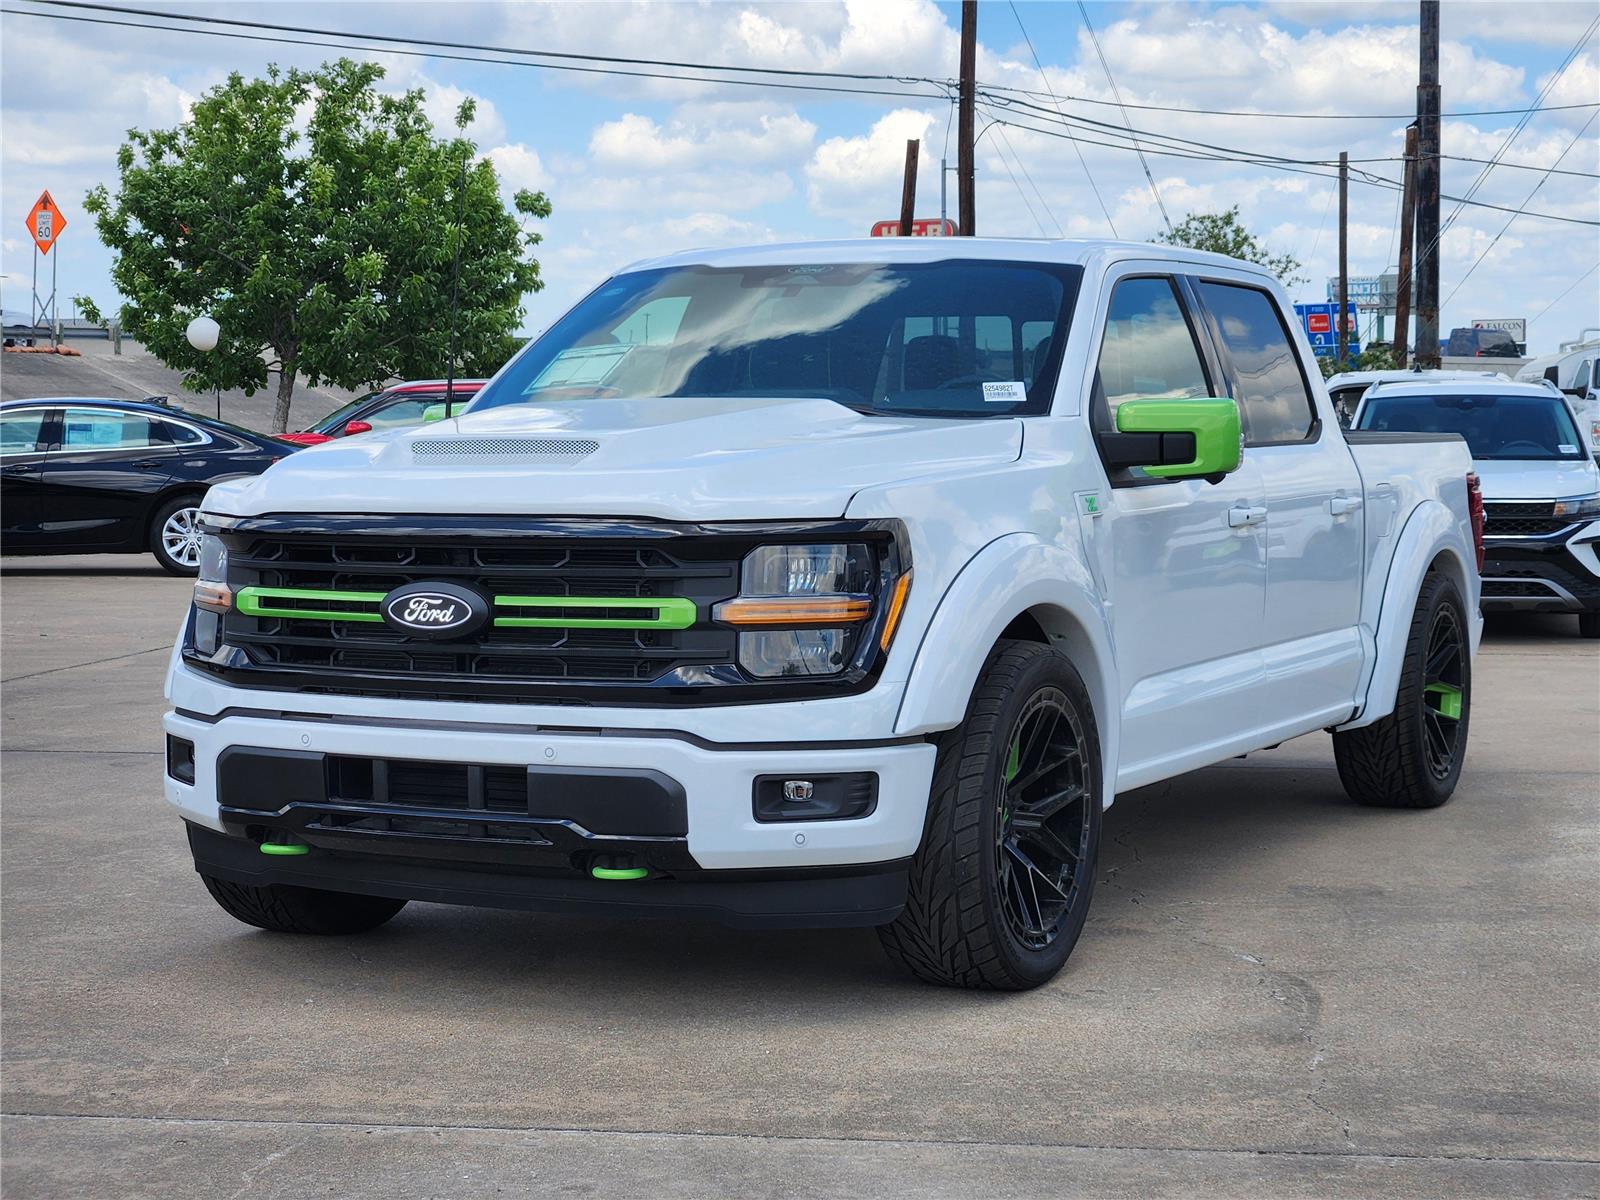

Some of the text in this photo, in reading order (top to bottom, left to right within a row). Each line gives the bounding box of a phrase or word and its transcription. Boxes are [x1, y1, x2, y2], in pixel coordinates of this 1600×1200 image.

[38, 226, 50, 238] 60
[1487, 321, 1523, 330] FALCON
[403, 597, 456, 623] Ford
